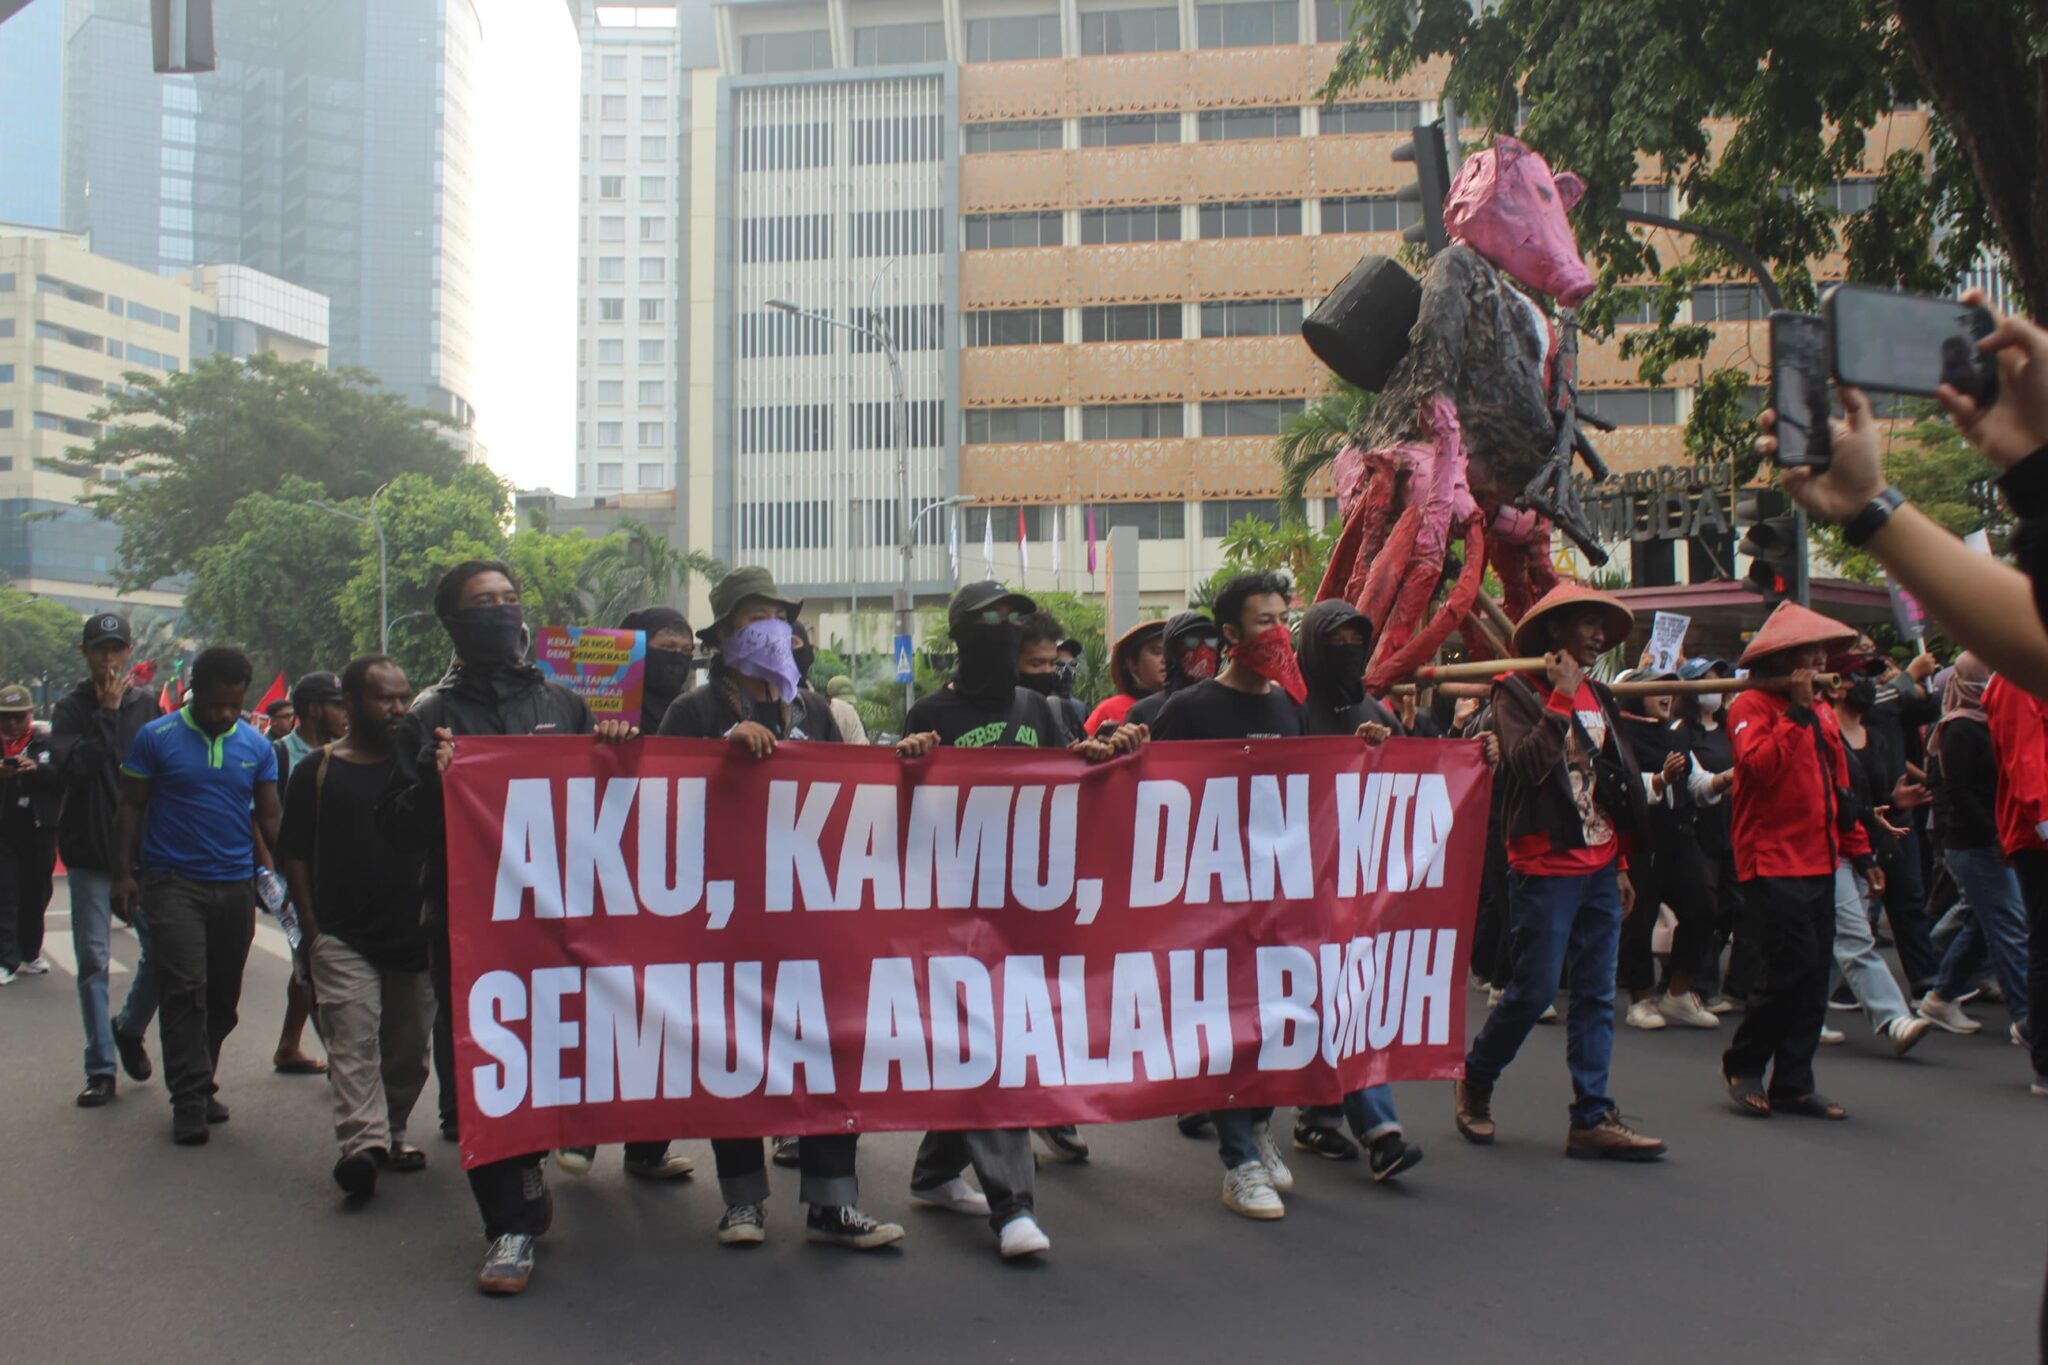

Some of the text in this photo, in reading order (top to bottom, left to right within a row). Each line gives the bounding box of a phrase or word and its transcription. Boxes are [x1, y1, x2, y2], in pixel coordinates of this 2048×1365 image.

[546, 637, 615, 648] KERJA DI NGO
[546, 649, 630, 661] DEMI DEMOKRASI
[585, 675, 618, 685] TANPA
[601, 688, 624, 697] GAJI
[589, 699, 620, 709] LISASI
[491, 771, 1455, 930] AKU, KAMU, DAN KITA
[467, 928, 1458, 1118] SEMUA ADALAH BURUH
